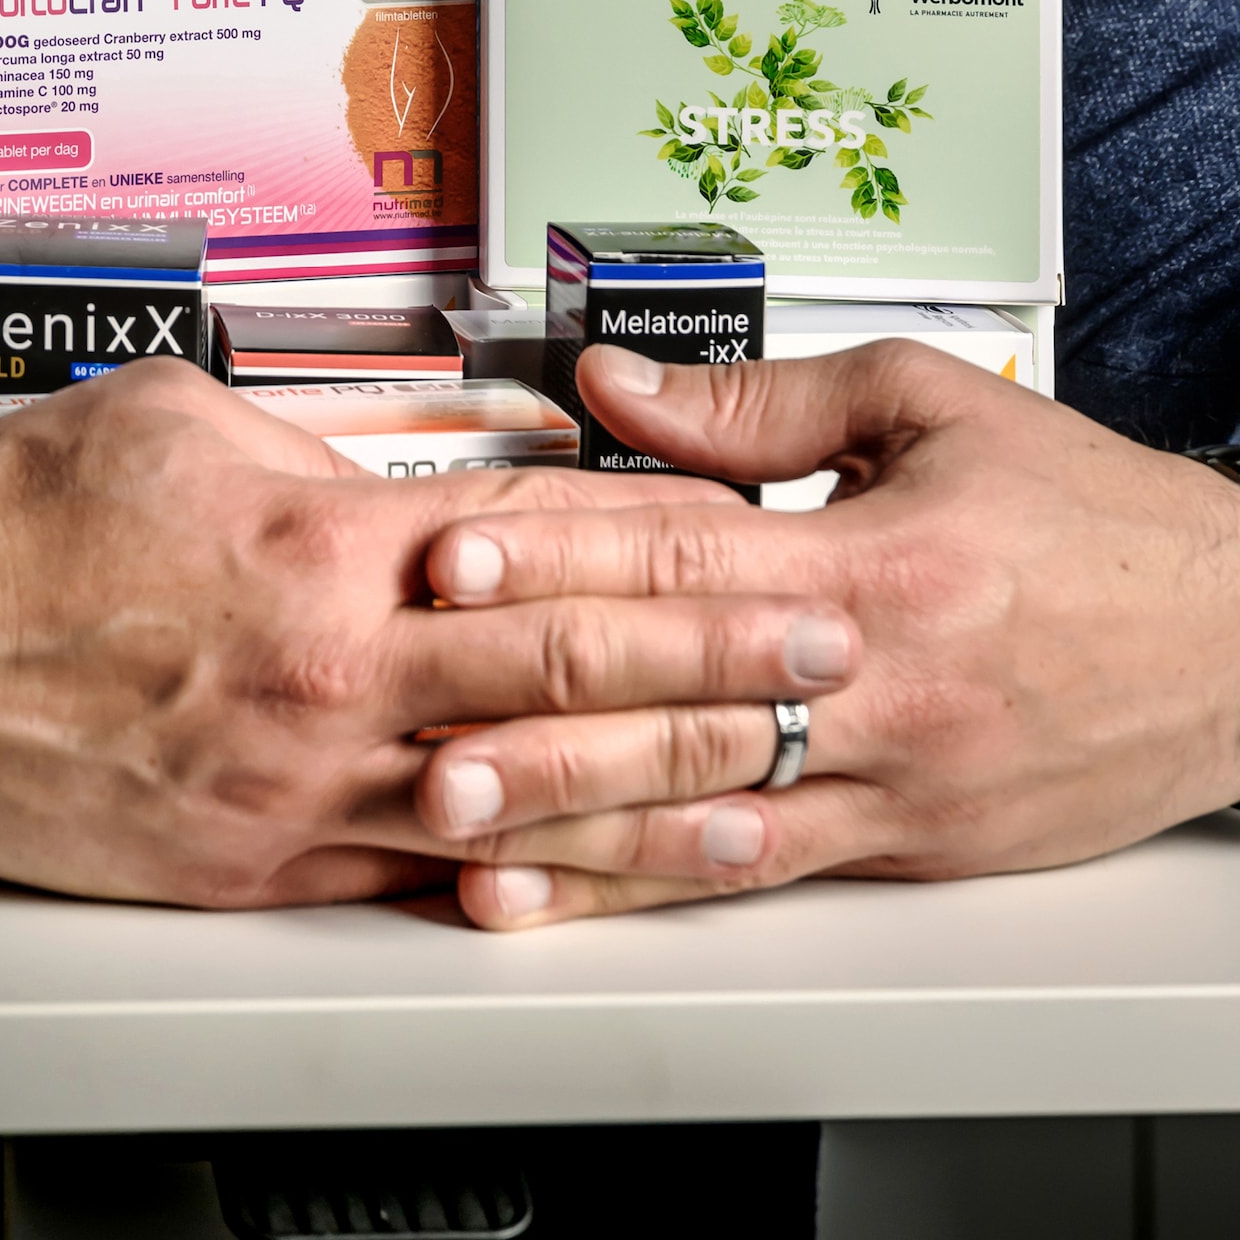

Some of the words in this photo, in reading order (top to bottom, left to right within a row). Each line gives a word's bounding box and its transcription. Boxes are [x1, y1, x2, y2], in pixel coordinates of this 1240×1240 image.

[375, 9, 439, 23] filmtabletten
[33, 34, 100, 50] gedoseerd
[103, 31, 166, 46] Cranberry
[169, 29, 213, 43] extract
[217, 28, 239, 40] 500
[242, 29, 261, 41] mg
[40, 52, 76, 68] longa
[79, 50, 123, 63] extract
[126, 49, 141, 61] 50
[144, 50, 164, 63] mg
[48, 68, 71, 80] 150
[74, 69, 94, 81] mg
[38, 86, 48, 97] C
[51, 85, 74, 97] 100
[77, 85, 97, 98] mg
[61, 101, 76, 113] 20
[79, 102, 99, 115] mg
[677, 105, 868, 149] STRESS
[30, 145, 52, 159] per
[55, 143, 79, 158] dag
[7, 176, 89, 192] COMPLETE
[91, 178, 106, 188] en
[109, 172, 164, 187] UNIEKE
[166, 170, 245, 185] samenstelling
[100, 195, 123, 210] en
[127, 189, 179, 208] urinair
[373, 197, 443, 211] nutrimed
[335, 312, 406, 322] 3000
[601, 309, 749, 335] Melatonine
[700, 339, 748, 363] -ixX
[74, 367, 86, 376] 60
[600, 453, 674, 469] MÉLATON
